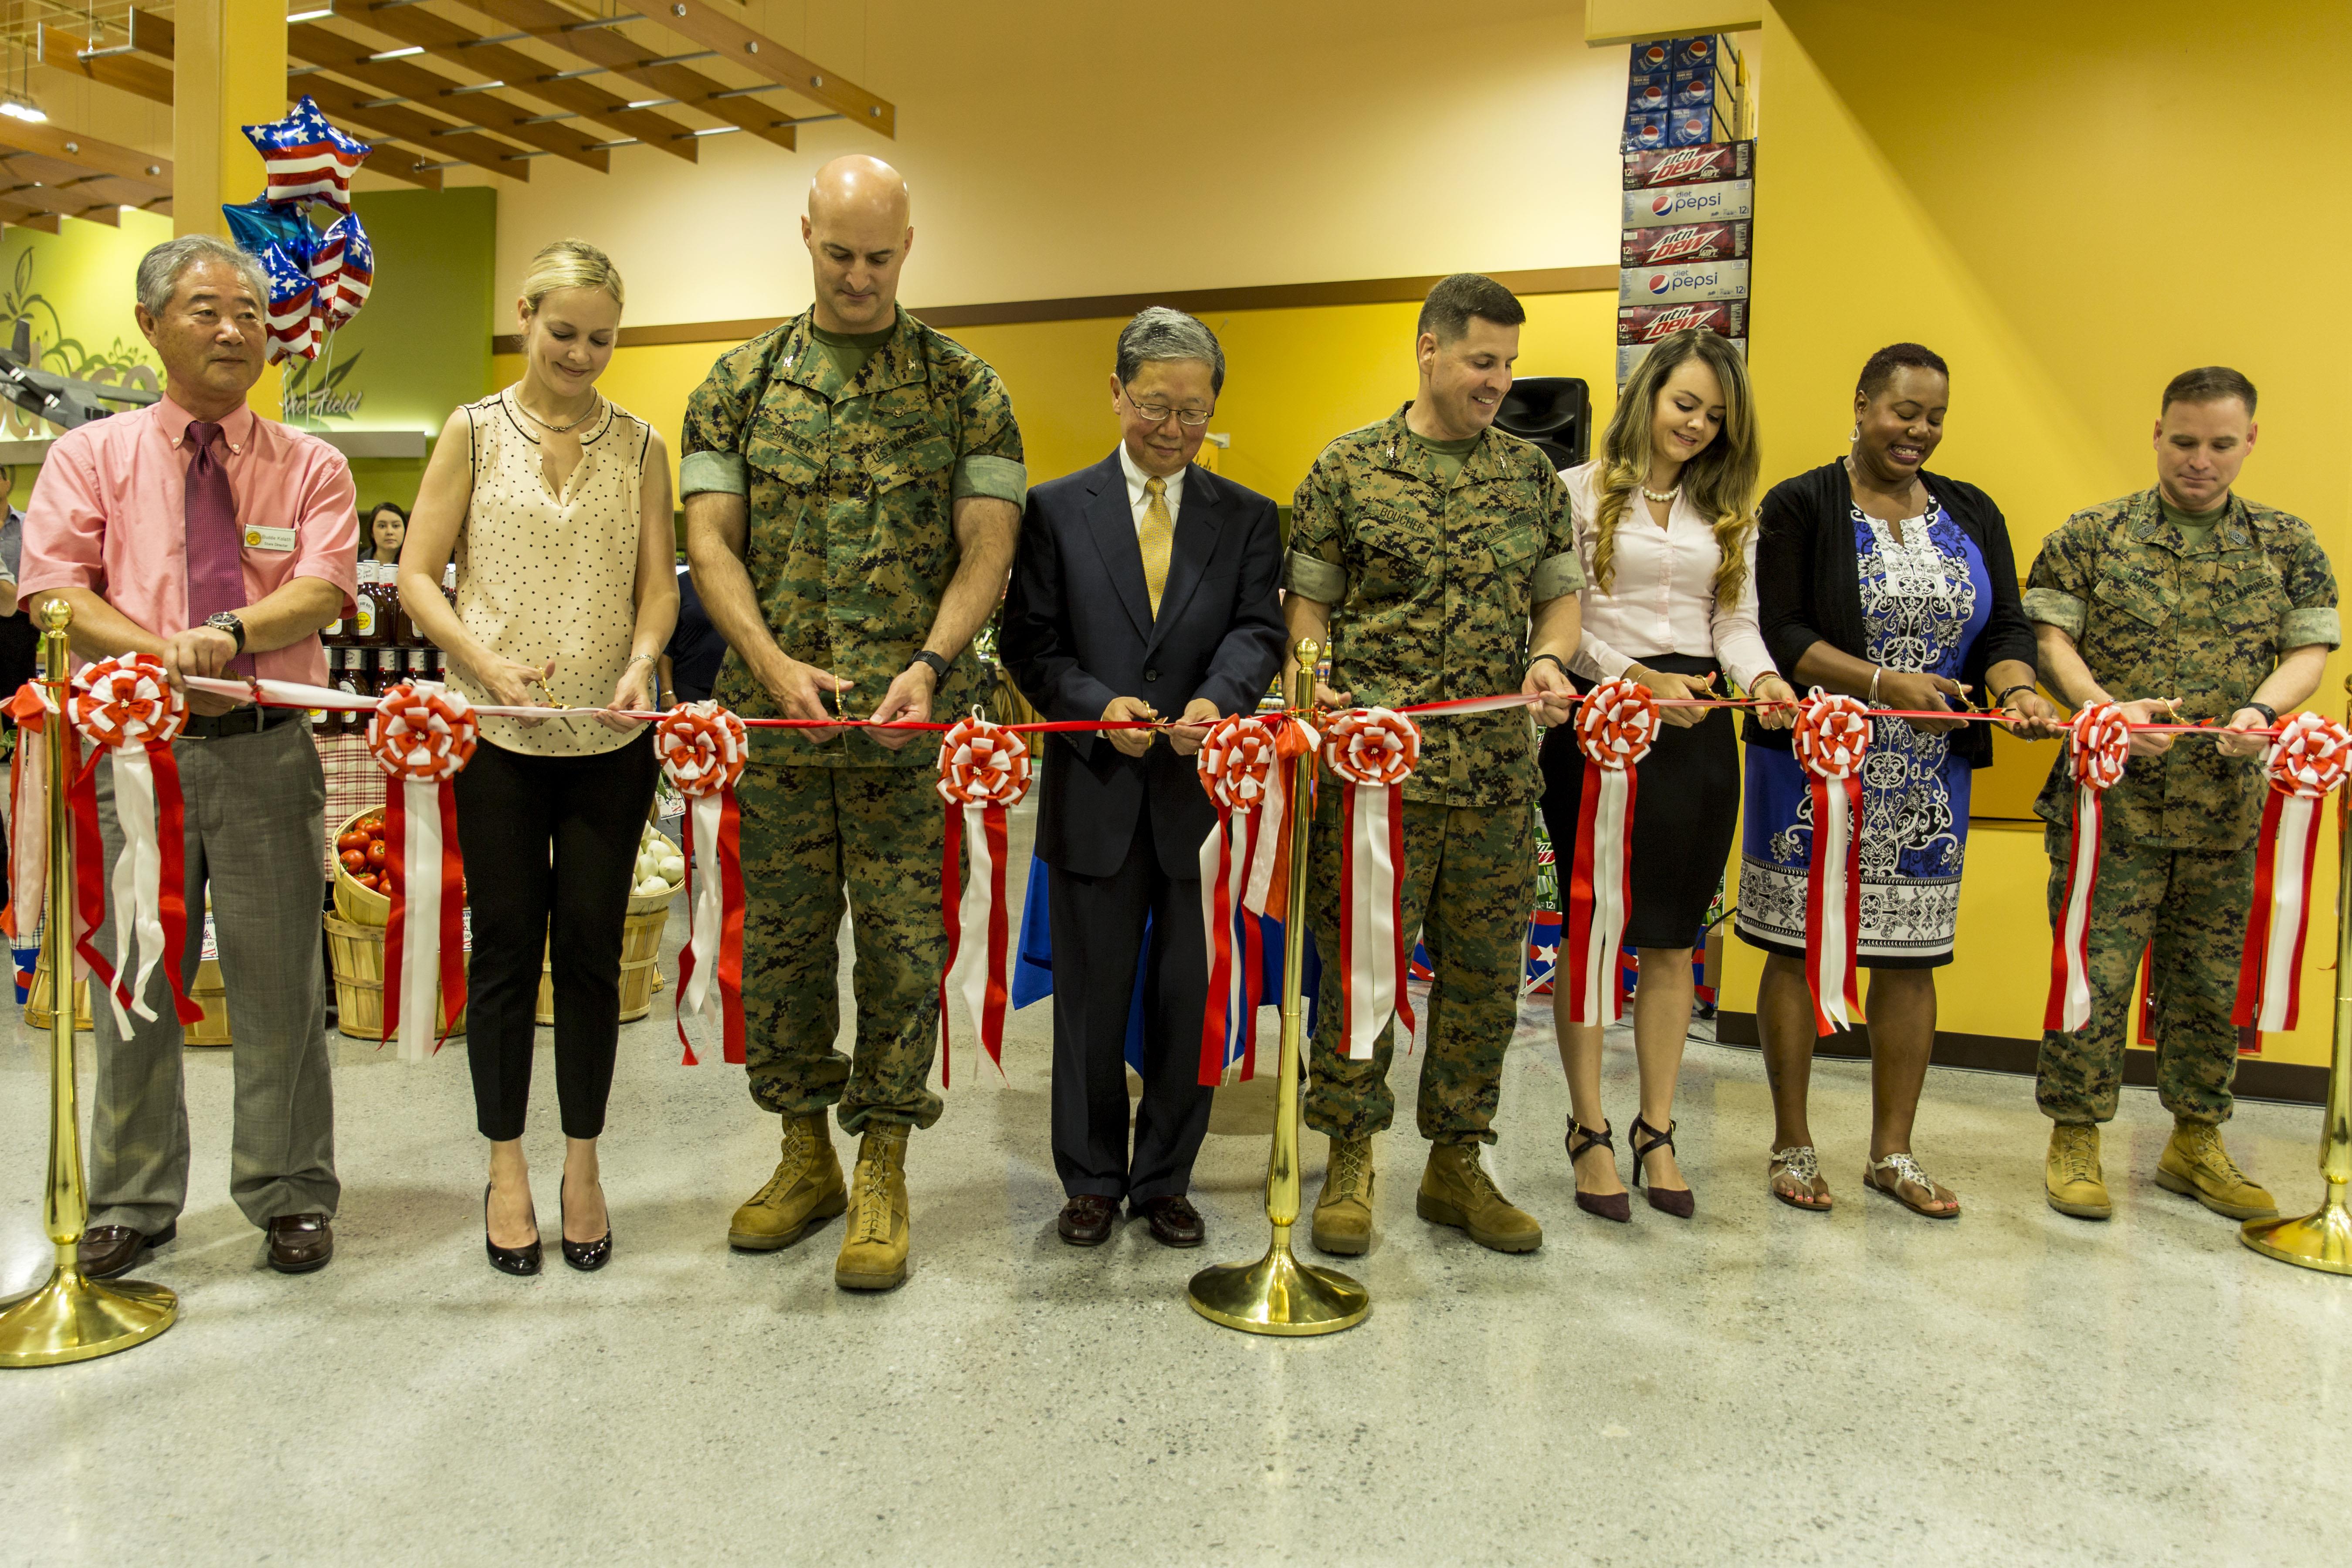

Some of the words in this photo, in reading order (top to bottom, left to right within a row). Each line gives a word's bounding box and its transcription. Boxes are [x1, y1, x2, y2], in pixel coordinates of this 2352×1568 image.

[1624, 169, 1632, 177] 12
[1675, 193, 1721, 212] pepsi
[1672, 272, 1718, 291] pepsi
[1619, 324, 1627, 332] 12
[309, 387, 363, 414] Field
[773, 426, 814, 453] SHIPLEY
[872, 448, 891, 463] U.S.
[889, 427, 931, 452] MARINES
[1380, 507, 1425, 533] BOUCHER
[1486, 524, 1506, 537] U.S.
[1505, 511, 1536, 530] MARINES
[2128, 574, 2160, 596] GARZA
[2216, 593, 2236, 606] U.S.
[2234, 577, 2274, 599] MARINES
